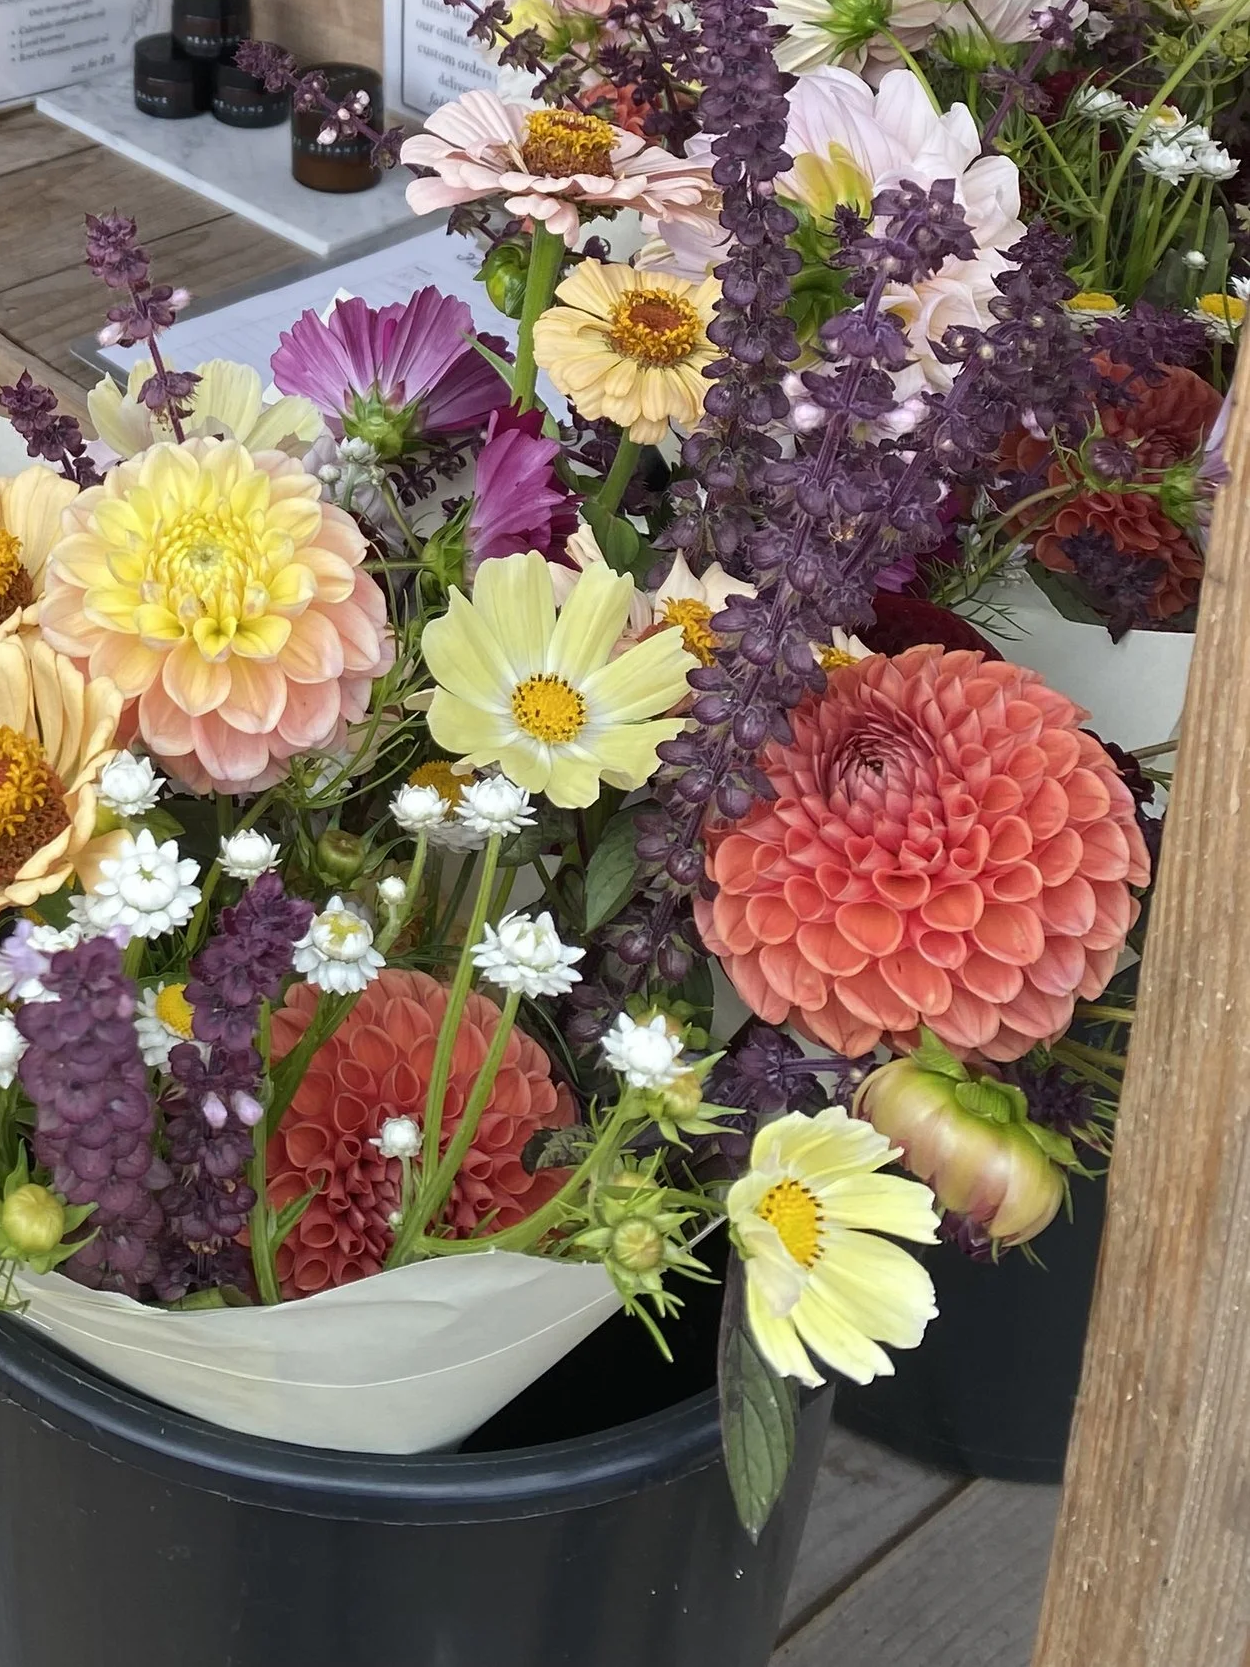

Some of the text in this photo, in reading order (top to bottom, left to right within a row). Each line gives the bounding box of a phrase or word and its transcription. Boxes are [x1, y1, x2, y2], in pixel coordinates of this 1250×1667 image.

[415, 19, 469, 48] our online
[417, 42, 492, 81] custom orders
